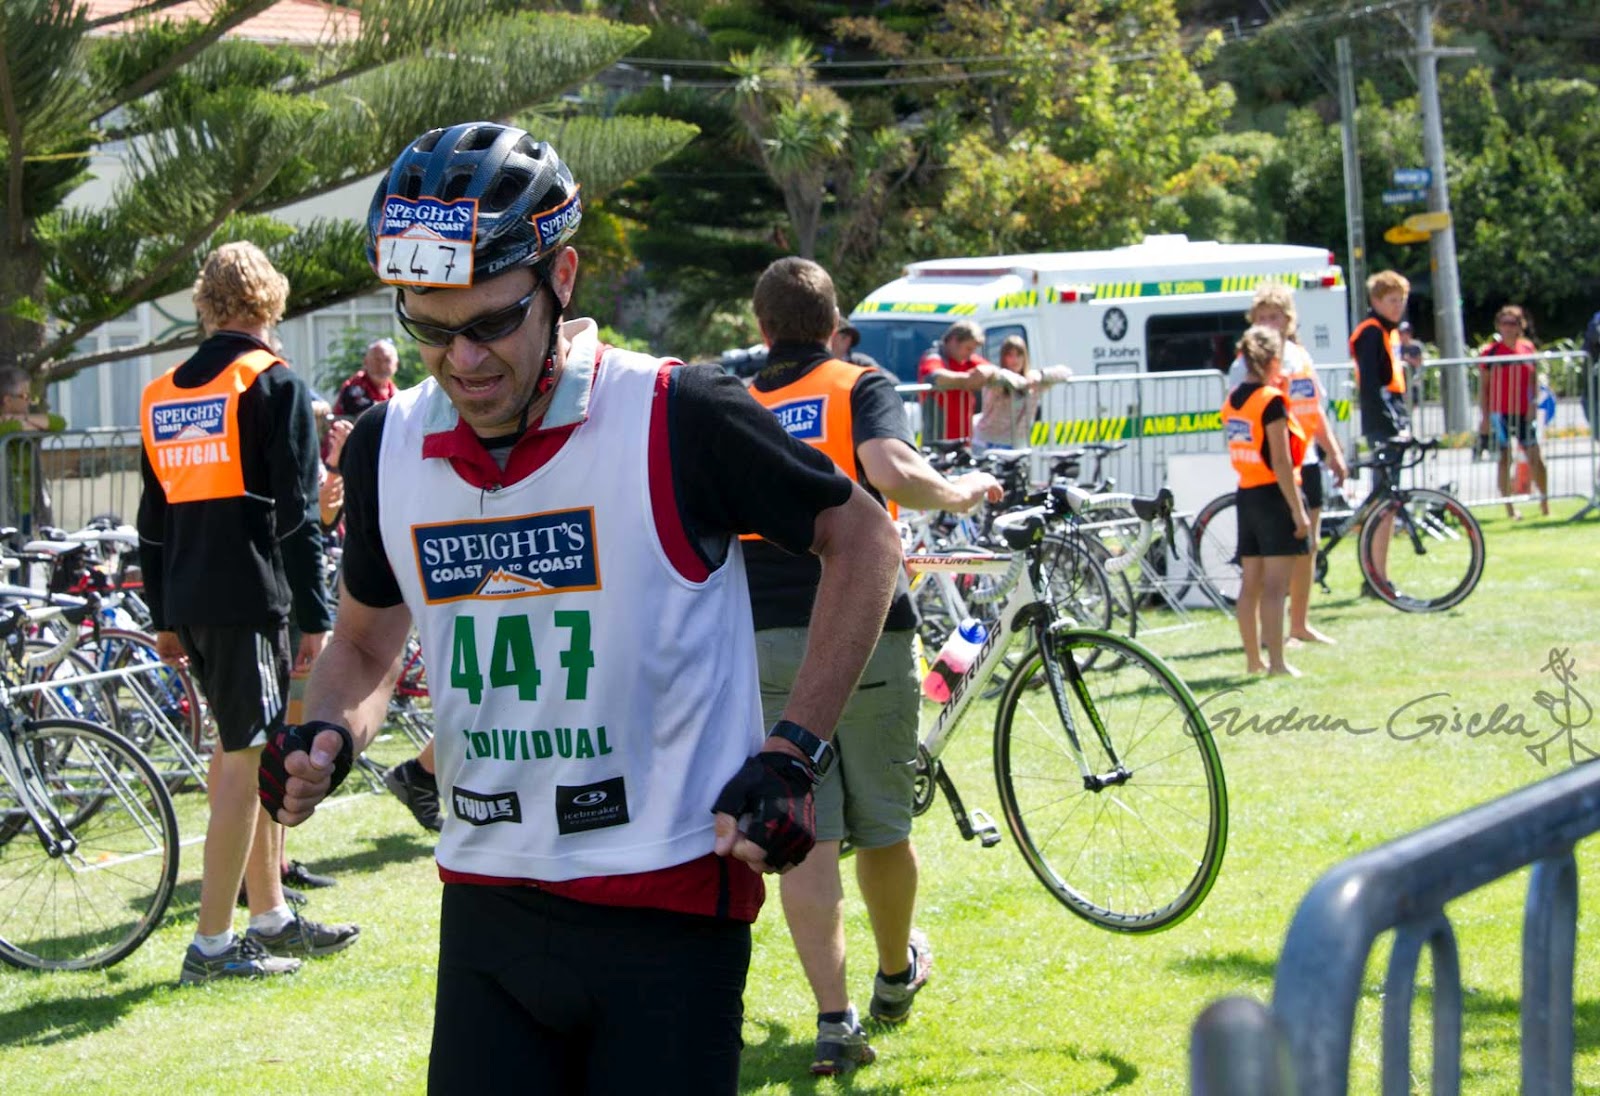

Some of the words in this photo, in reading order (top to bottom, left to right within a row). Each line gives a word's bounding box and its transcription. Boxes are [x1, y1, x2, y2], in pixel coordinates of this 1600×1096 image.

[386, 204, 470, 222] SPEGHT'S
[433, 222, 465, 231] COAST
[387, 241, 456, 281] 447
[1108, 345, 1140, 358] John
[154, 403, 223, 424] SPEIGHT'S
[422, 522, 585, 566] SPEIGHT'S
[431, 564, 484, 583] COAST
[508, 563, 522, 572] TO
[528, 555, 584, 574] COAST
[450, 610, 595, 705] 447
[463, 726, 613, 761] DIVIDUAL
[455, 796, 514, 821] THULE
[564, 804, 621, 821] icebreaker
